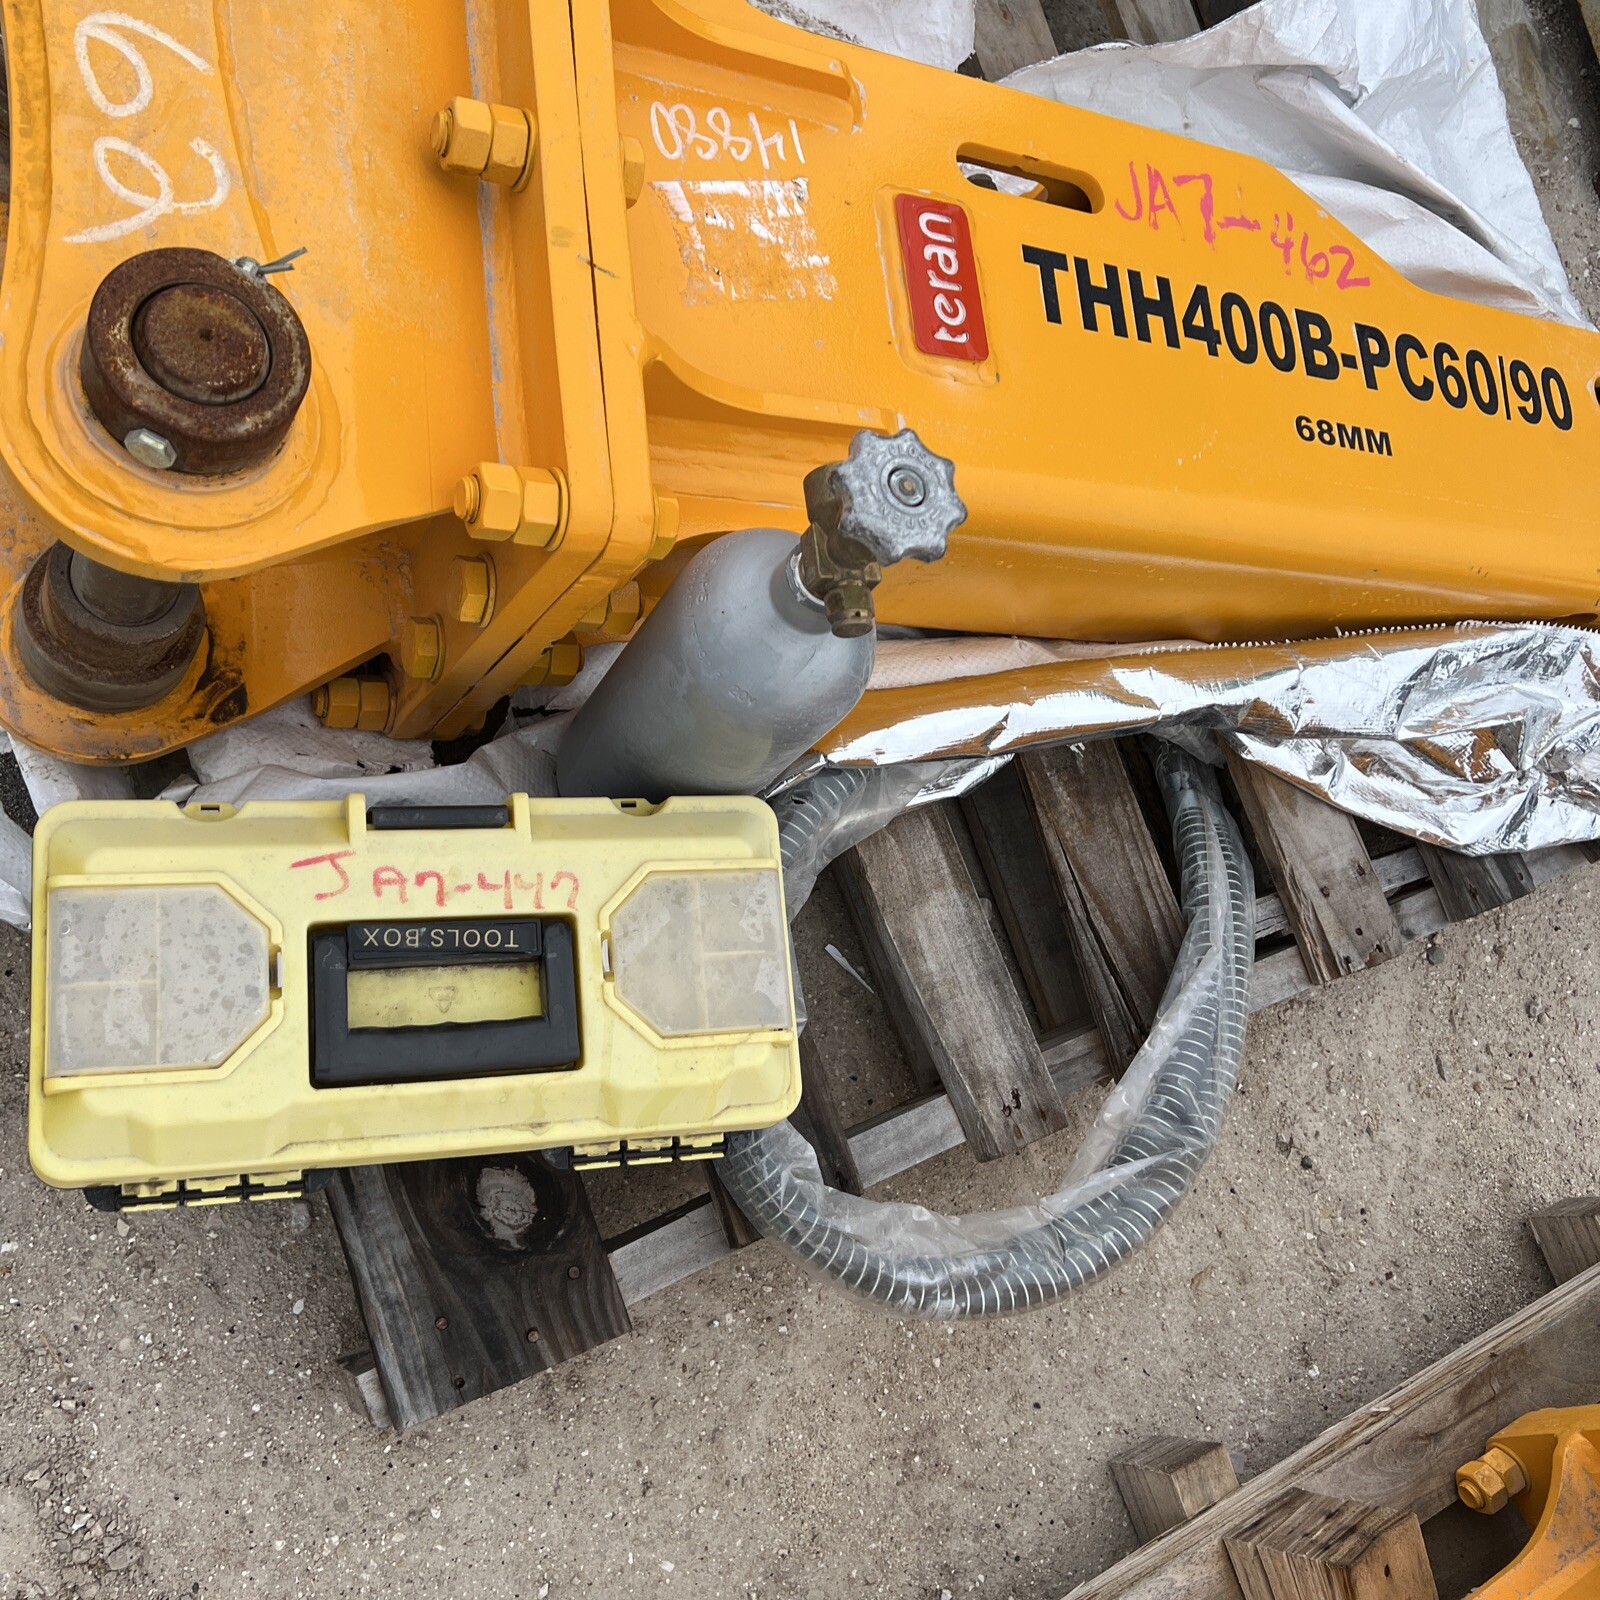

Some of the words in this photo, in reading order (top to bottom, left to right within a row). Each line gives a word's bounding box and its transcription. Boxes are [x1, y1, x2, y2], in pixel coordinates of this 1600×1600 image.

[650, 101, 806, 169] 14880
[1115, 161, 1371, 290] JA7-462
[918, 211, 969, 344] teran
[1022, 244, 1574, 432] THH400B-PC60/90
[1295, 415, 1394, 457] 68MM
[362, 927, 418, 948] BOX
[431, 928, 520, 948] TOOLS
